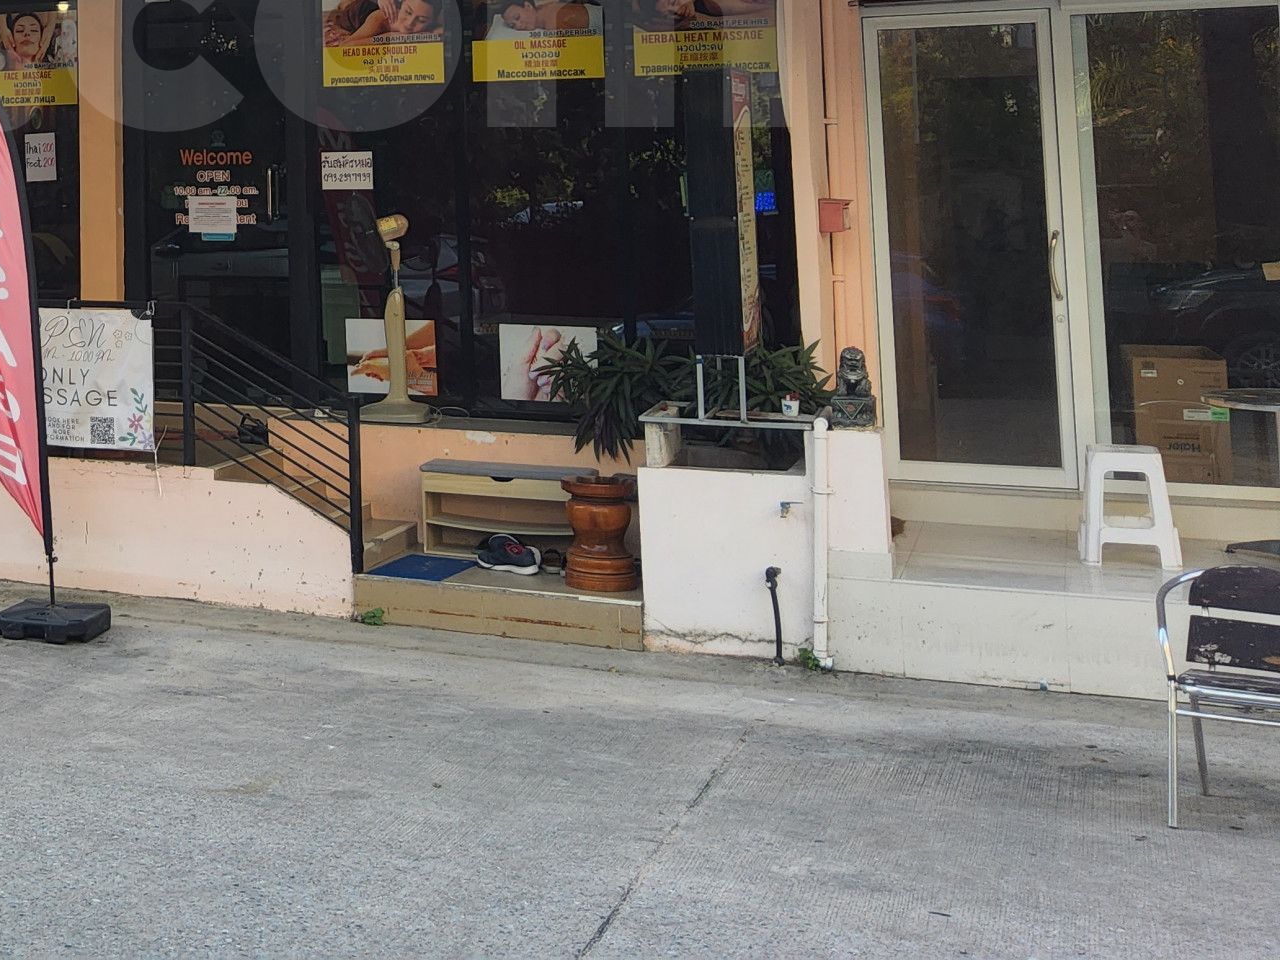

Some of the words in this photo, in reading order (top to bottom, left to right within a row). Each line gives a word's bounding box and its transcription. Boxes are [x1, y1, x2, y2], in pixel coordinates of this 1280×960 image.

[641, 33, 681, 45] HERBAL
[684, 32, 709, 43] HEAT
[713, 30, 764, 42] MASSAGE
[514, 40, 526, 50] OIL
[530, 39, 567, 49] MASSAGE
[342, 48, 360, 57] HEAD
[362, 47, 380, 56] BACK
[382, 45, 417, 56] SHOULDER
[4, 71, 19, 80] FACE
[22, 71, 52, 80] MASSAGE
[330, 74, 377, 85] руководитель
[380, 73, 412, 84] Обратная
[497, 69, 547, 79] Массовый
[549, 68, 586, 77] массаж
[33, 96, 56, 104] лица
[25, 141, 41, 155] Thai
[179, 148, 253, 166] Welcome
[196, 170, 231, 182] OPEN
[174, 186, 196, 195] 10.00
[40, 315, 107, 348] PEN
[44, 387, 118, 407] SSAGE
[62, 417, 79, 425] HERE
[61, 423, 76, 431] FOR
[47, 434, 85, 442] ORMATION
